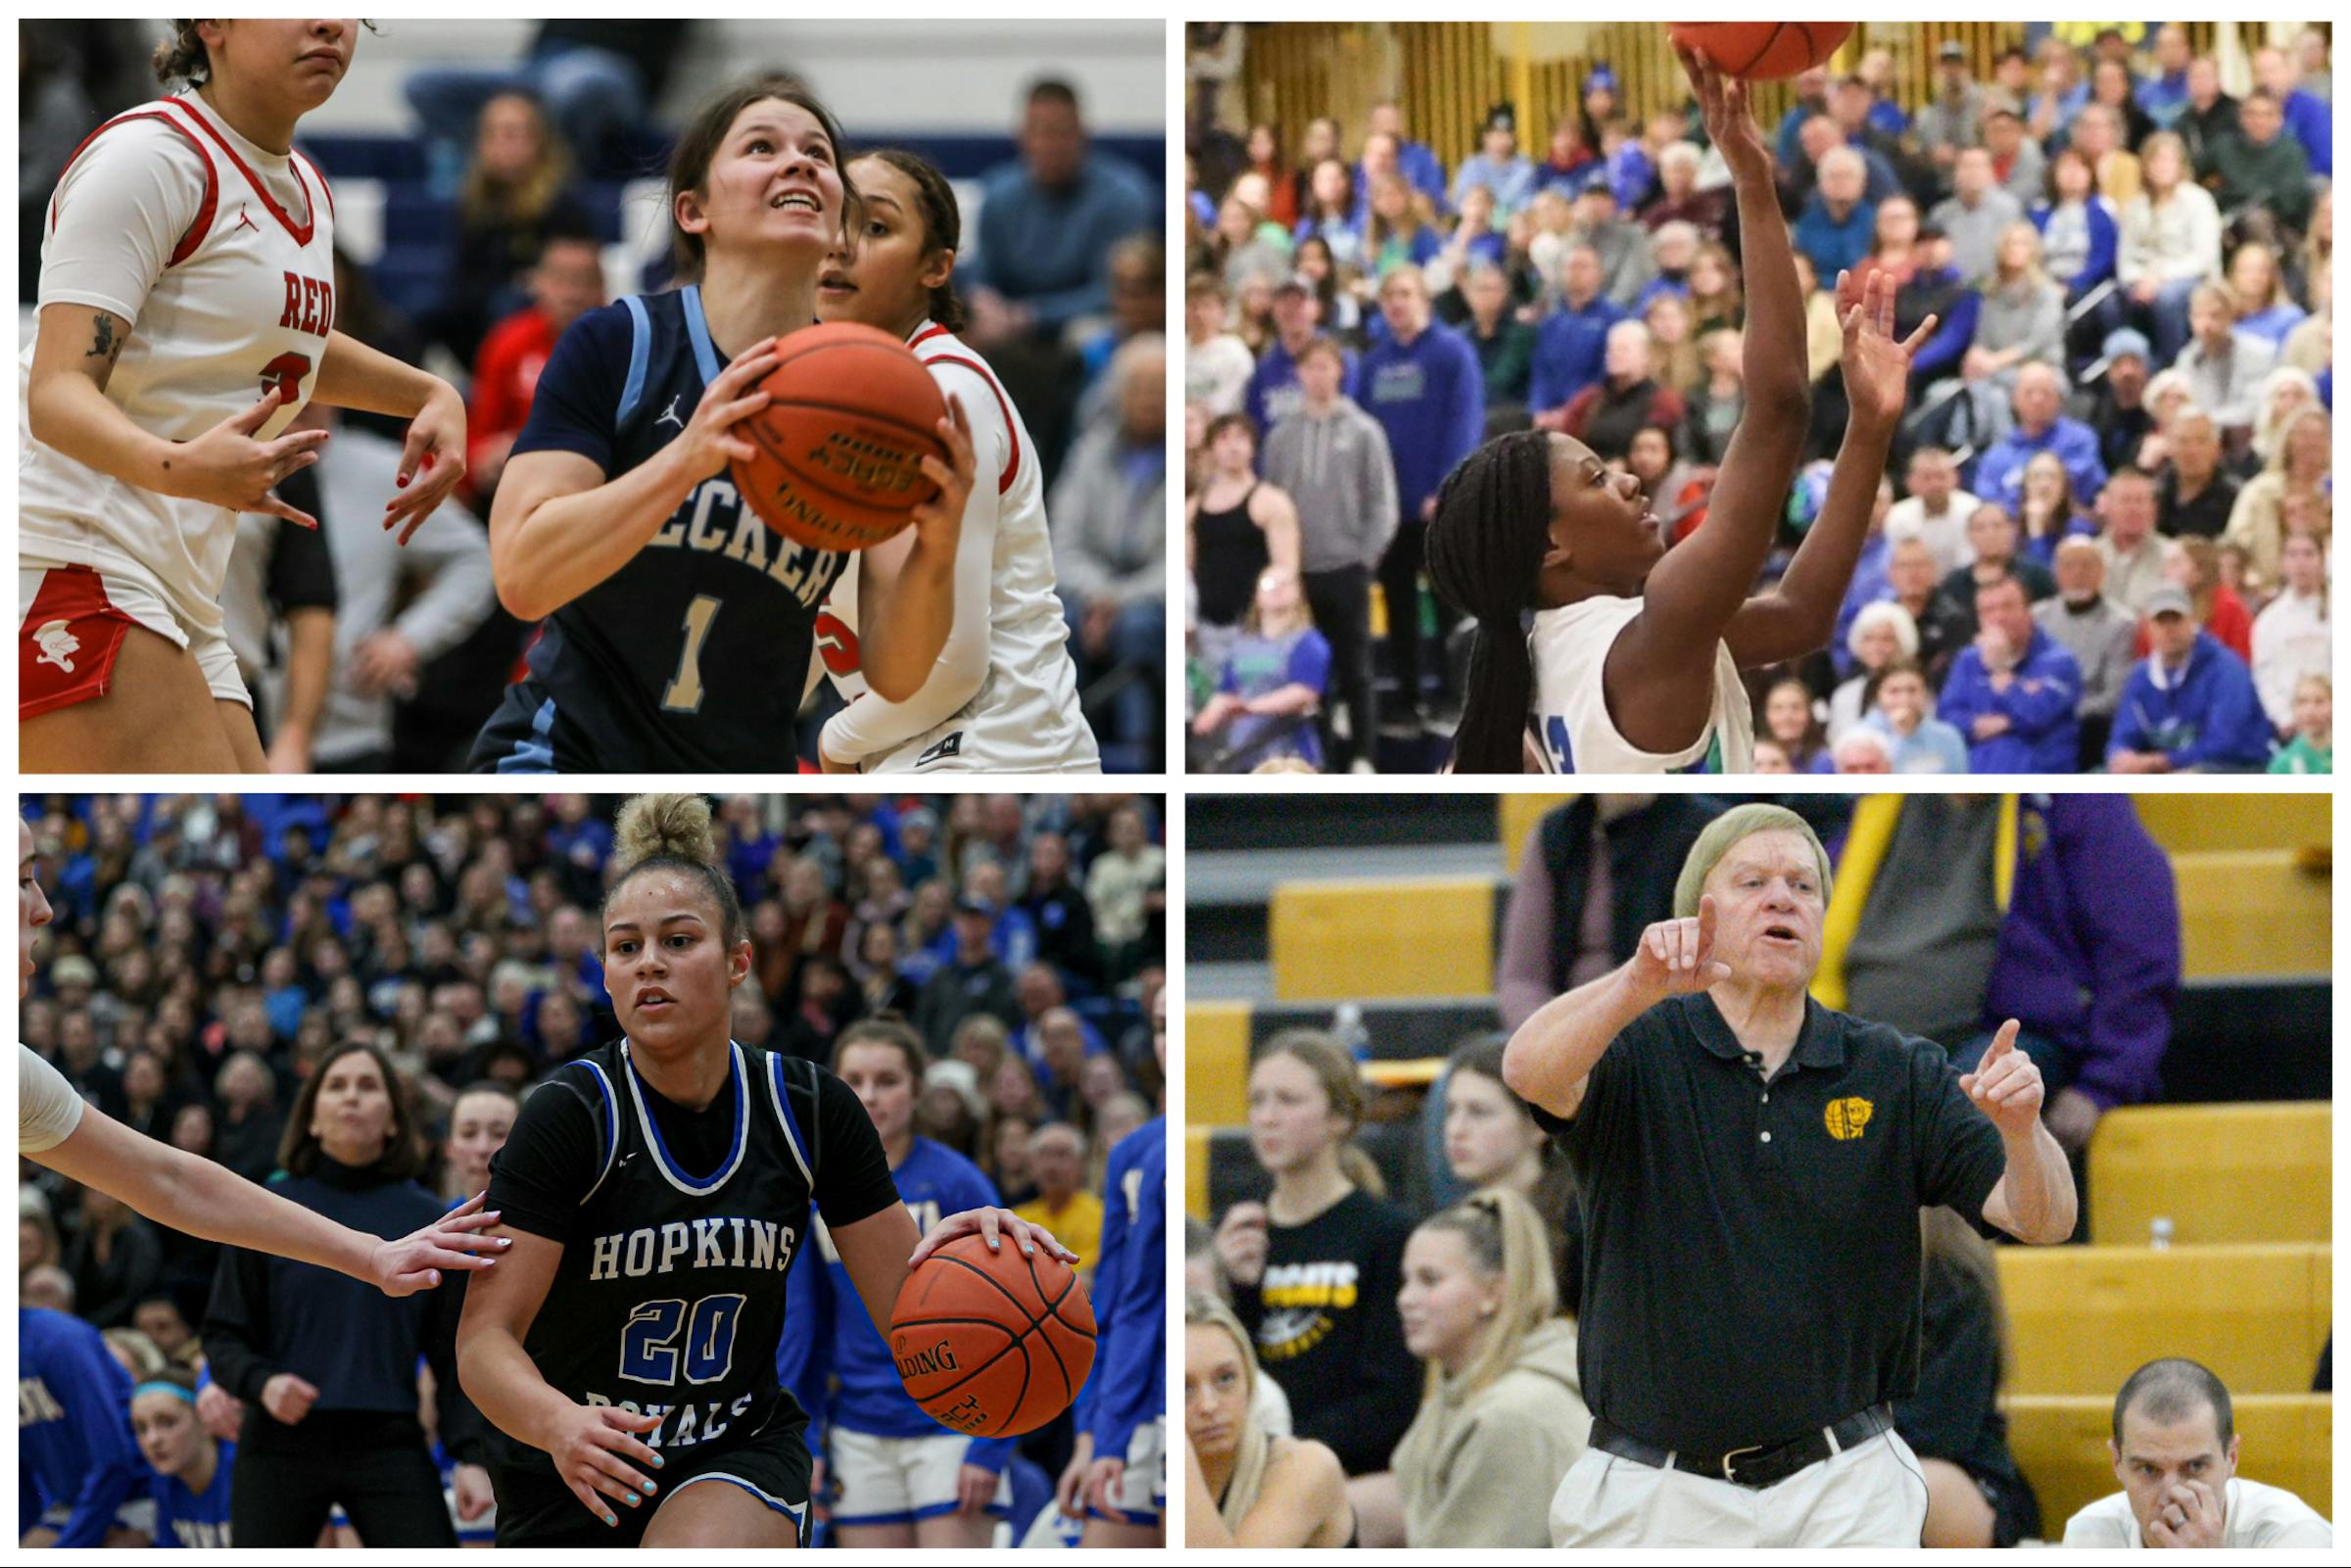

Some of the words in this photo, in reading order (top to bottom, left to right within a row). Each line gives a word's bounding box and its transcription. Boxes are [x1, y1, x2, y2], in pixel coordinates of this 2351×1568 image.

[279, 270, 333, 338] RED
[647, 479, 837, 608] ECKER
[659, 593, 723, 714] 1
[590, 1217, 794, 1281] HOPKINS
[618, 1293, 747, 1387] 20
